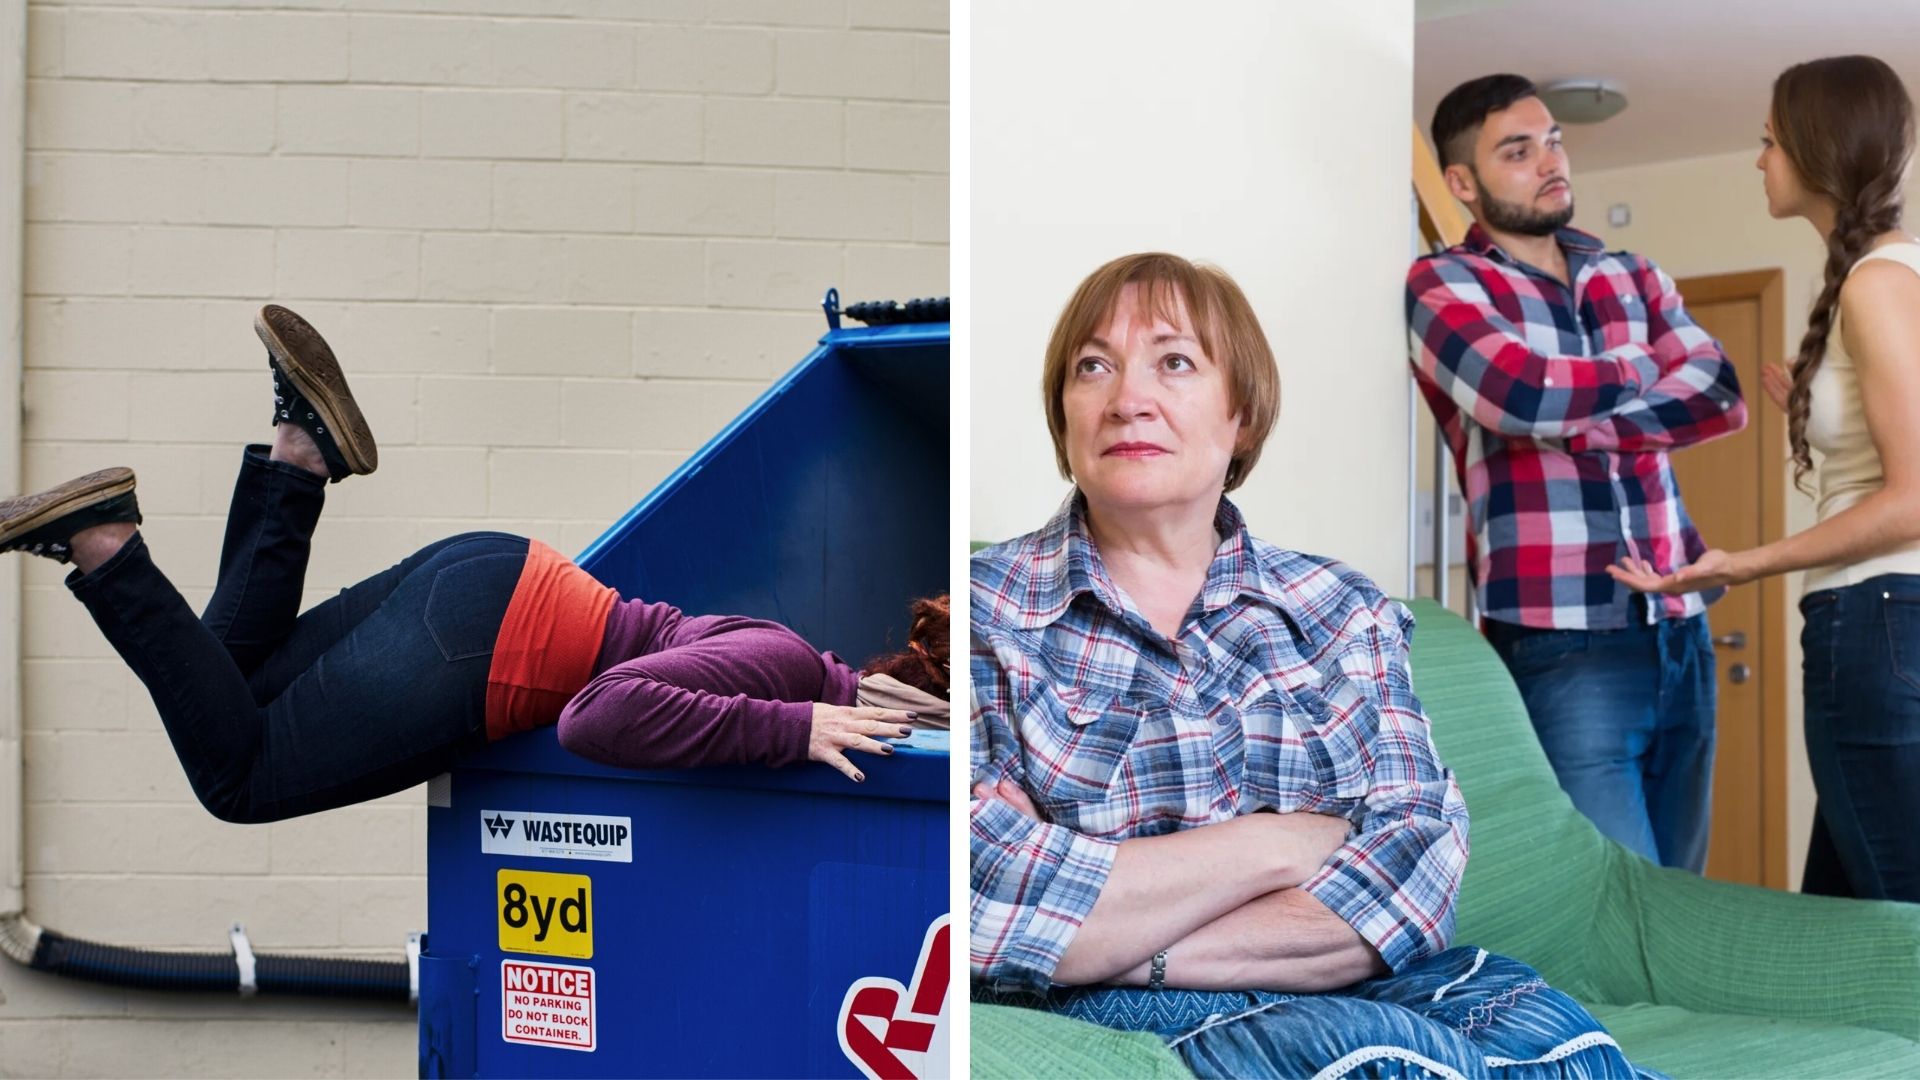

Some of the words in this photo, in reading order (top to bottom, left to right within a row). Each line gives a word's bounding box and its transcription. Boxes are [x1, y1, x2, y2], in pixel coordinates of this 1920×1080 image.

[522, 819, 628, 847] WASTEQUIP
[503, 882, 587, 942] 8yd
[506, 966, 589, 997] NOTICE
[514, 995, 530, 1006] NO
[533, 997, 582, 1011] PARKING
[508, 1009, 523, 1020] DO
[526, 1011, 548, 1022] NOT
[552, 1013, 588, 1027] BLOCK
[515, 1024, 582, 1041] CONTAINER.
